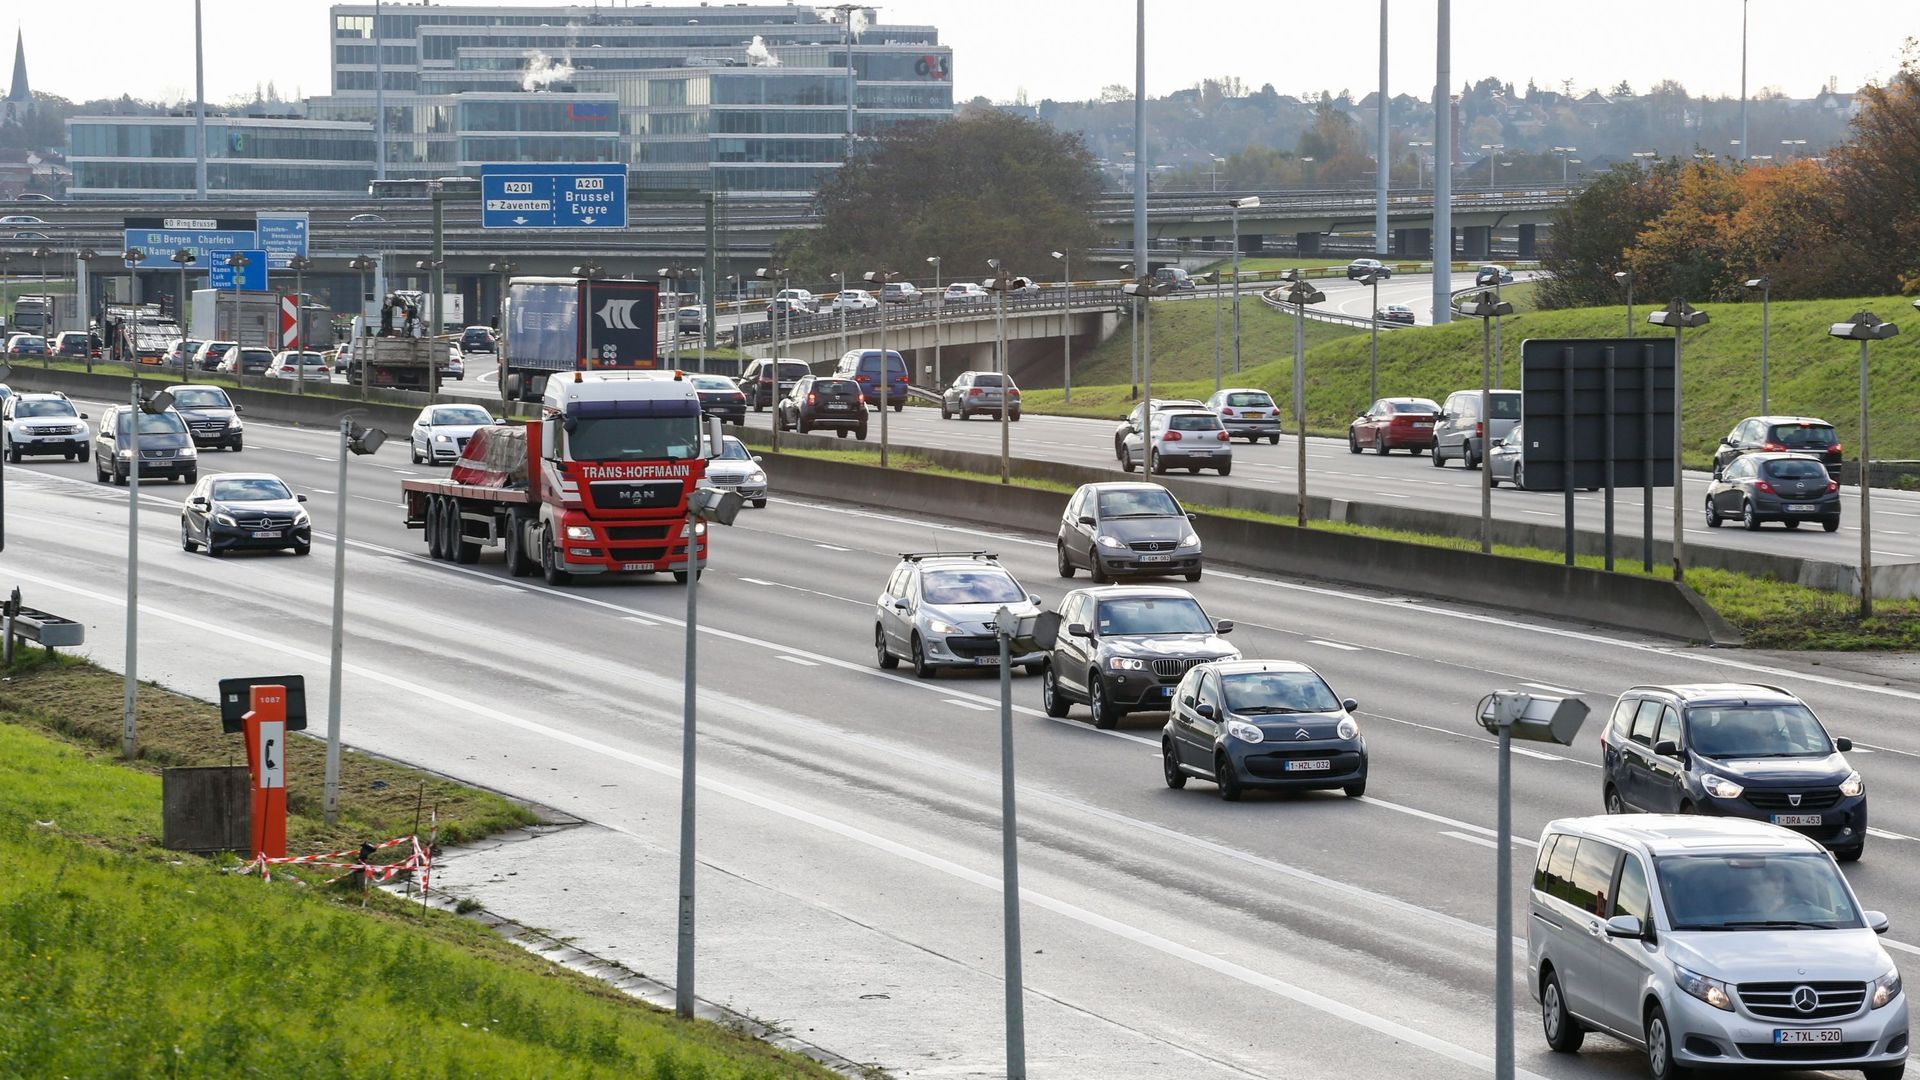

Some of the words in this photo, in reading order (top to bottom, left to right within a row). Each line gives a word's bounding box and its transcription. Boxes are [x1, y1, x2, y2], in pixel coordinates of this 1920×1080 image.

[506, 184, 531, 192] A201
[577, 180, 602, 188] A201
[565, 192, 614, 202] Brussel
[500, 201, 550, 210] Zaventem
[572, 204, 608, 214] Evere
[164, 234, 191, 246] Bergen
[198, 236, 234, 244] Charleroi
[149, 248, 176, 256] Namen
[583, 465, 690, 478] TRANS-HOFFMANN
[619, 490, 655, 499] MAN
[1777, 816, 1820, 824] 1-DRA-453
[1782, 1031, 1840, 1042] 2-TXL-520
